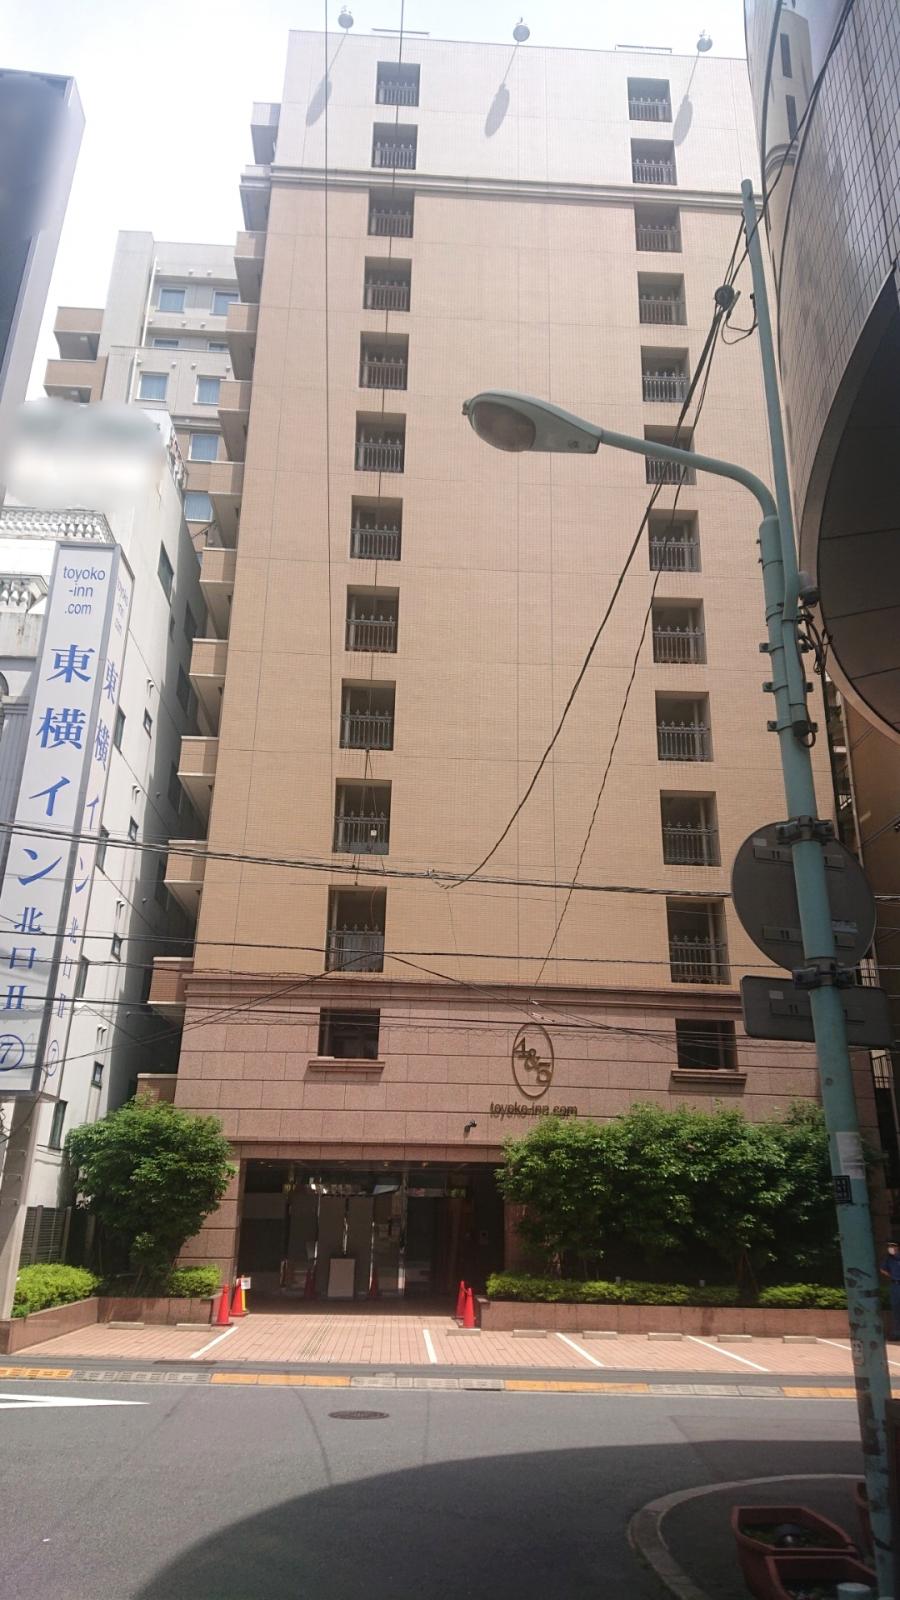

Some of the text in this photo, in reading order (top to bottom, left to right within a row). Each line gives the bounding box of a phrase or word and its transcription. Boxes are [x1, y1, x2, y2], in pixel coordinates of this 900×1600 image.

[63, 566, 106, 584] toyoko
[68, 584, 94, 597] -inn
[64, 603, 92, 616] .com
[490, 1101, 578, 1119] toyoko-inncom
